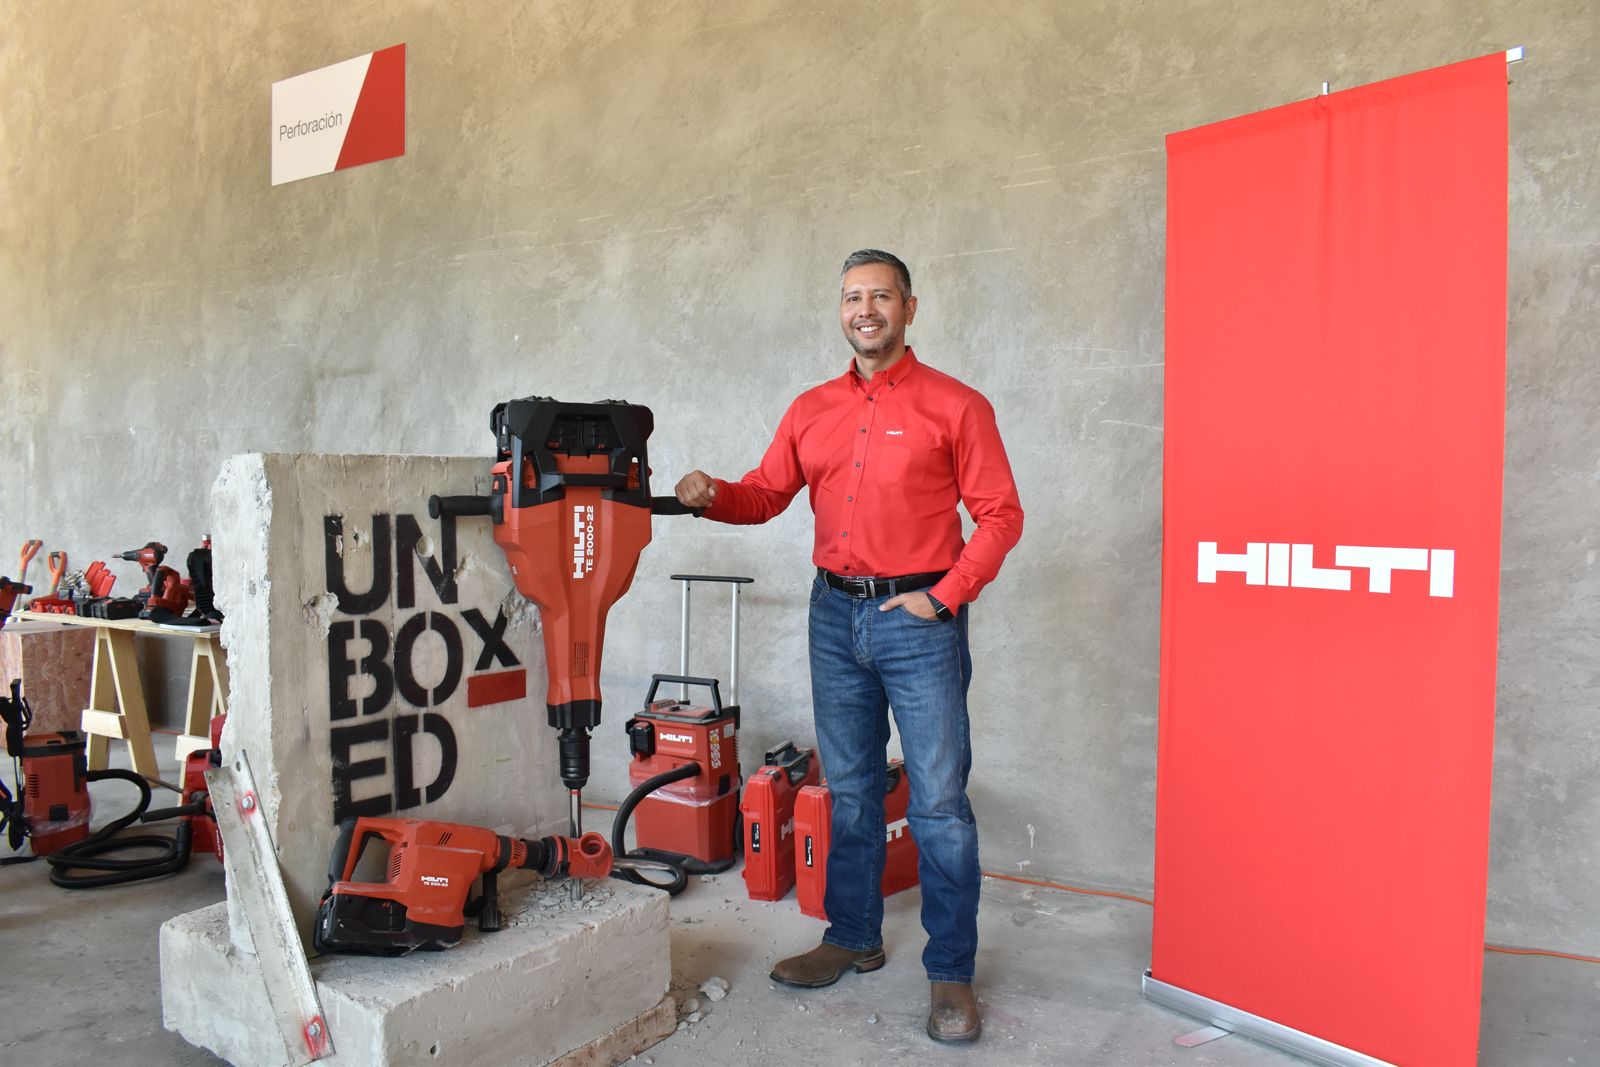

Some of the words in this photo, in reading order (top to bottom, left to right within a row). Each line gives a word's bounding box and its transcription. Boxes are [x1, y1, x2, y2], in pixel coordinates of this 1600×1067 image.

[279, 110, 342, 141] Perforación
[573, 505, 585, 579] HILTI
[586, 505, 594, 556] 2000-22
[324, 513, 458, 615] UN
[586, 558, 593, 573] TE
[1197, 541, 1455, 598] HILTI
[327, 604, 522, 721] BOX
[660, 733, 693, 743] HILTI
[330, 712, 458, 826] ED
